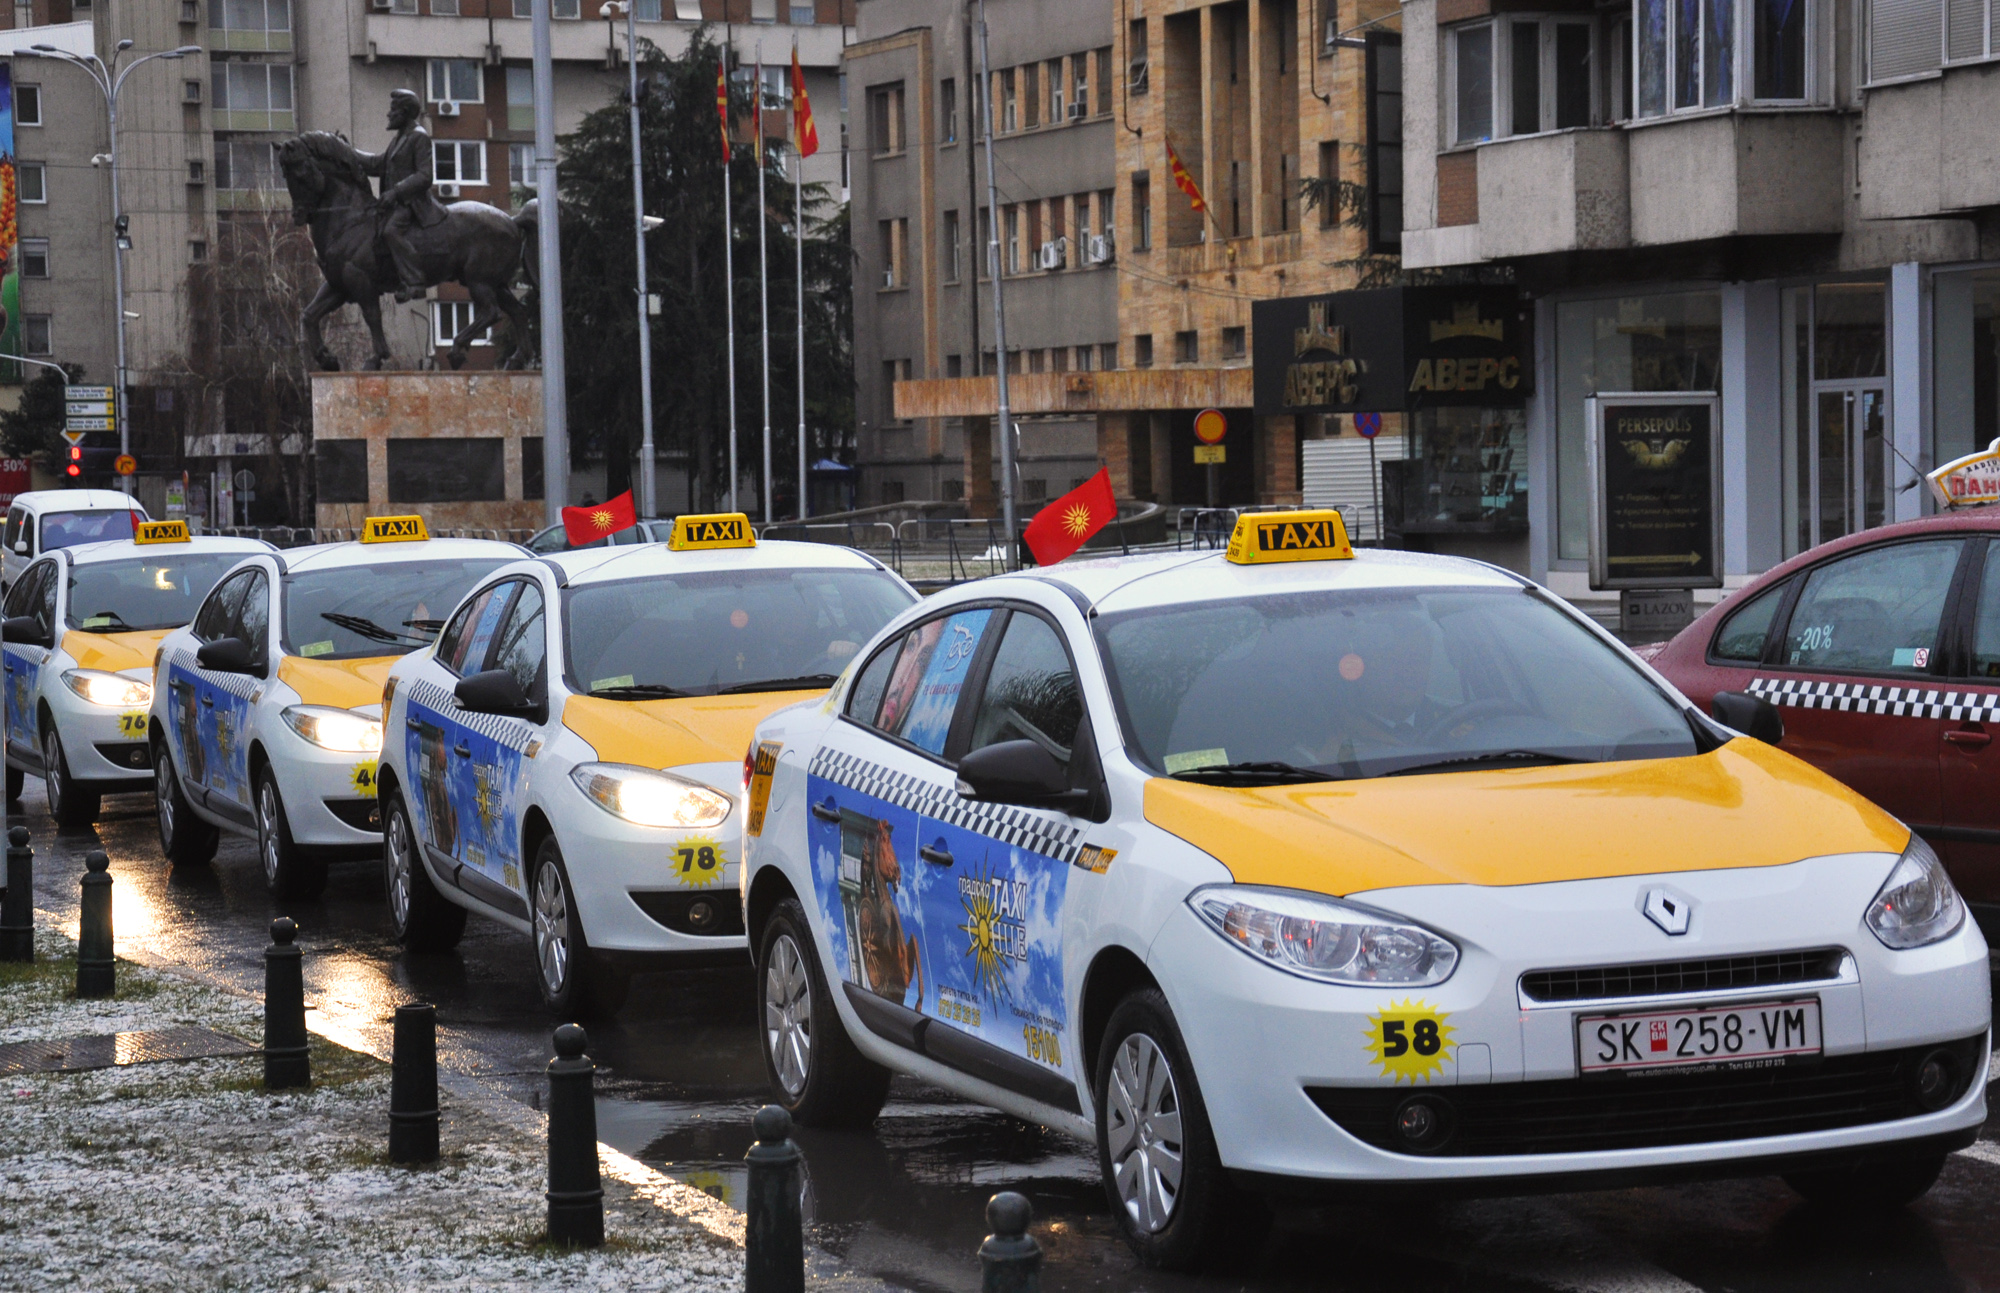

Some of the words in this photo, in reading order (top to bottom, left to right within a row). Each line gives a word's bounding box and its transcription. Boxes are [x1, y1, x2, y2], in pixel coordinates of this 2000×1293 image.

[1409, 356, 1520, 391] АВЕРС
[1618, 417, 1692, 433] PERSEPOLIS
[1951, 475, 2000, 496] ПАН
[145, 526, 180, 539] TAXI
[375, 521, 416, 536] TAXI
[688, 521, 740, 541] TAXI
[1260, 522, 1331, 549] TAXI
[1644, 602, 1688, 615] LAZOV
[1796, 625, 1834, 651] -20%
[122, 715, 146, 731] 76
[757, 746, 778, 773] TAXI
[678, 846, 716, 872] 78
[1078, 847, 1098, 866] TAXI
[958, 876, 991, 899] градско
[991, 877, 1028, 921] TAXI
[1023, 1023, 1062, 1068] 15100
[1382, 1018, 1441, 1058] 58
[1598, 1021, 1643, 1063] SK
